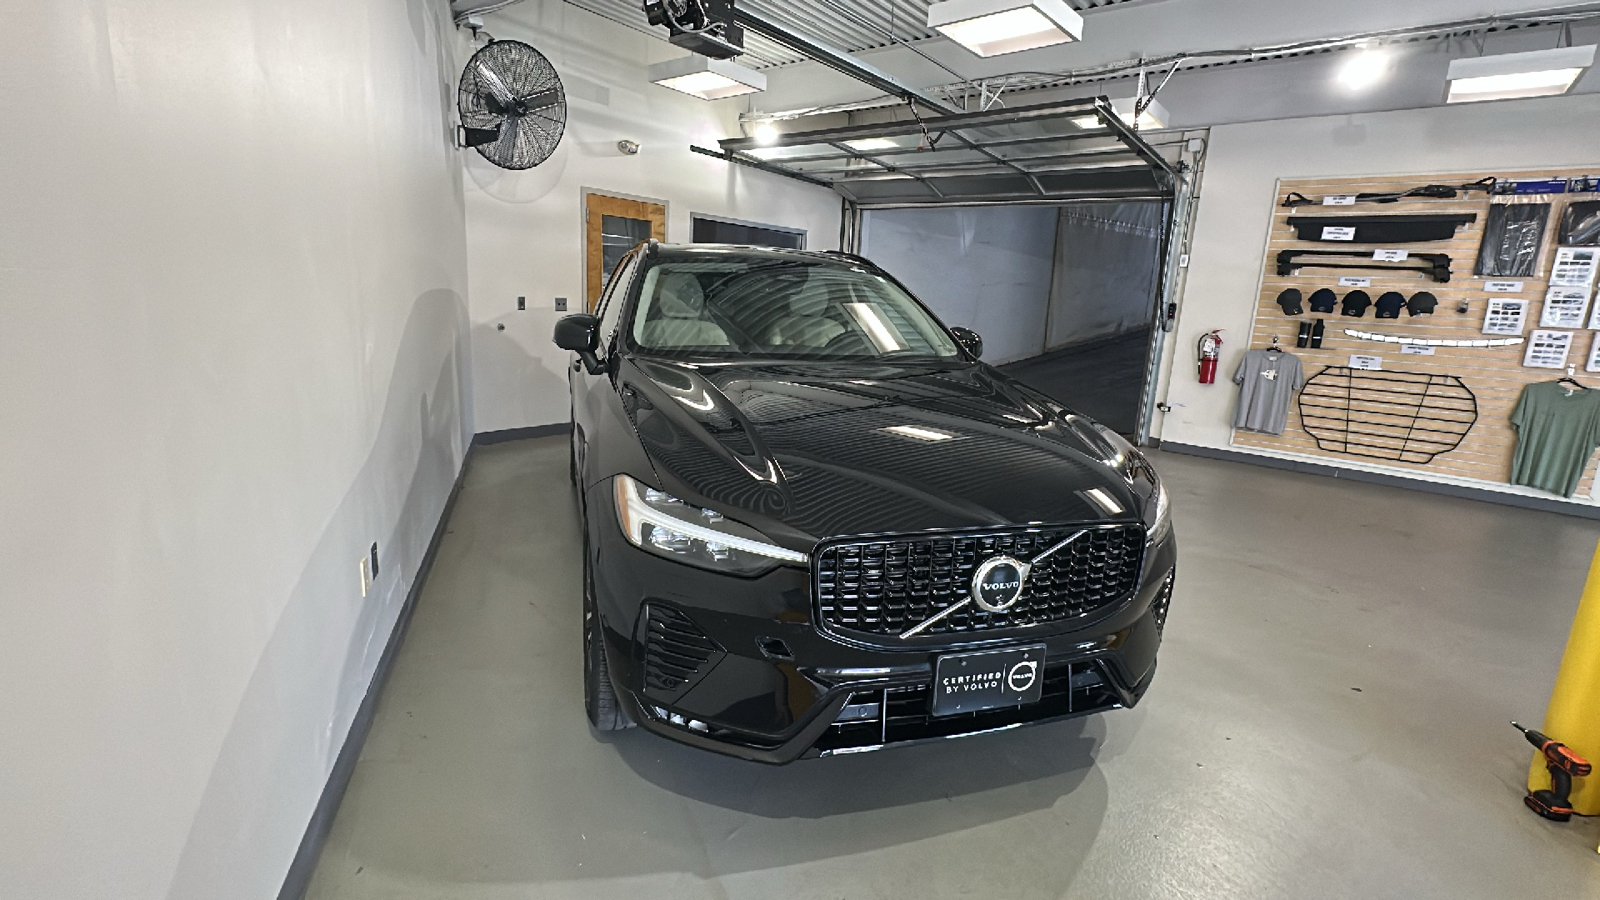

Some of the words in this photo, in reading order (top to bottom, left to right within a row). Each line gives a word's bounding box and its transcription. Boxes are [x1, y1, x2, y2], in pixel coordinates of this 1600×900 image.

[982, 581, 1019, 591] VOLVO
[943, 671, 1001, 686] CERTIFIED
[946, 686, 959, 694] BY
[964, 681, 998, 692] VOLVO
